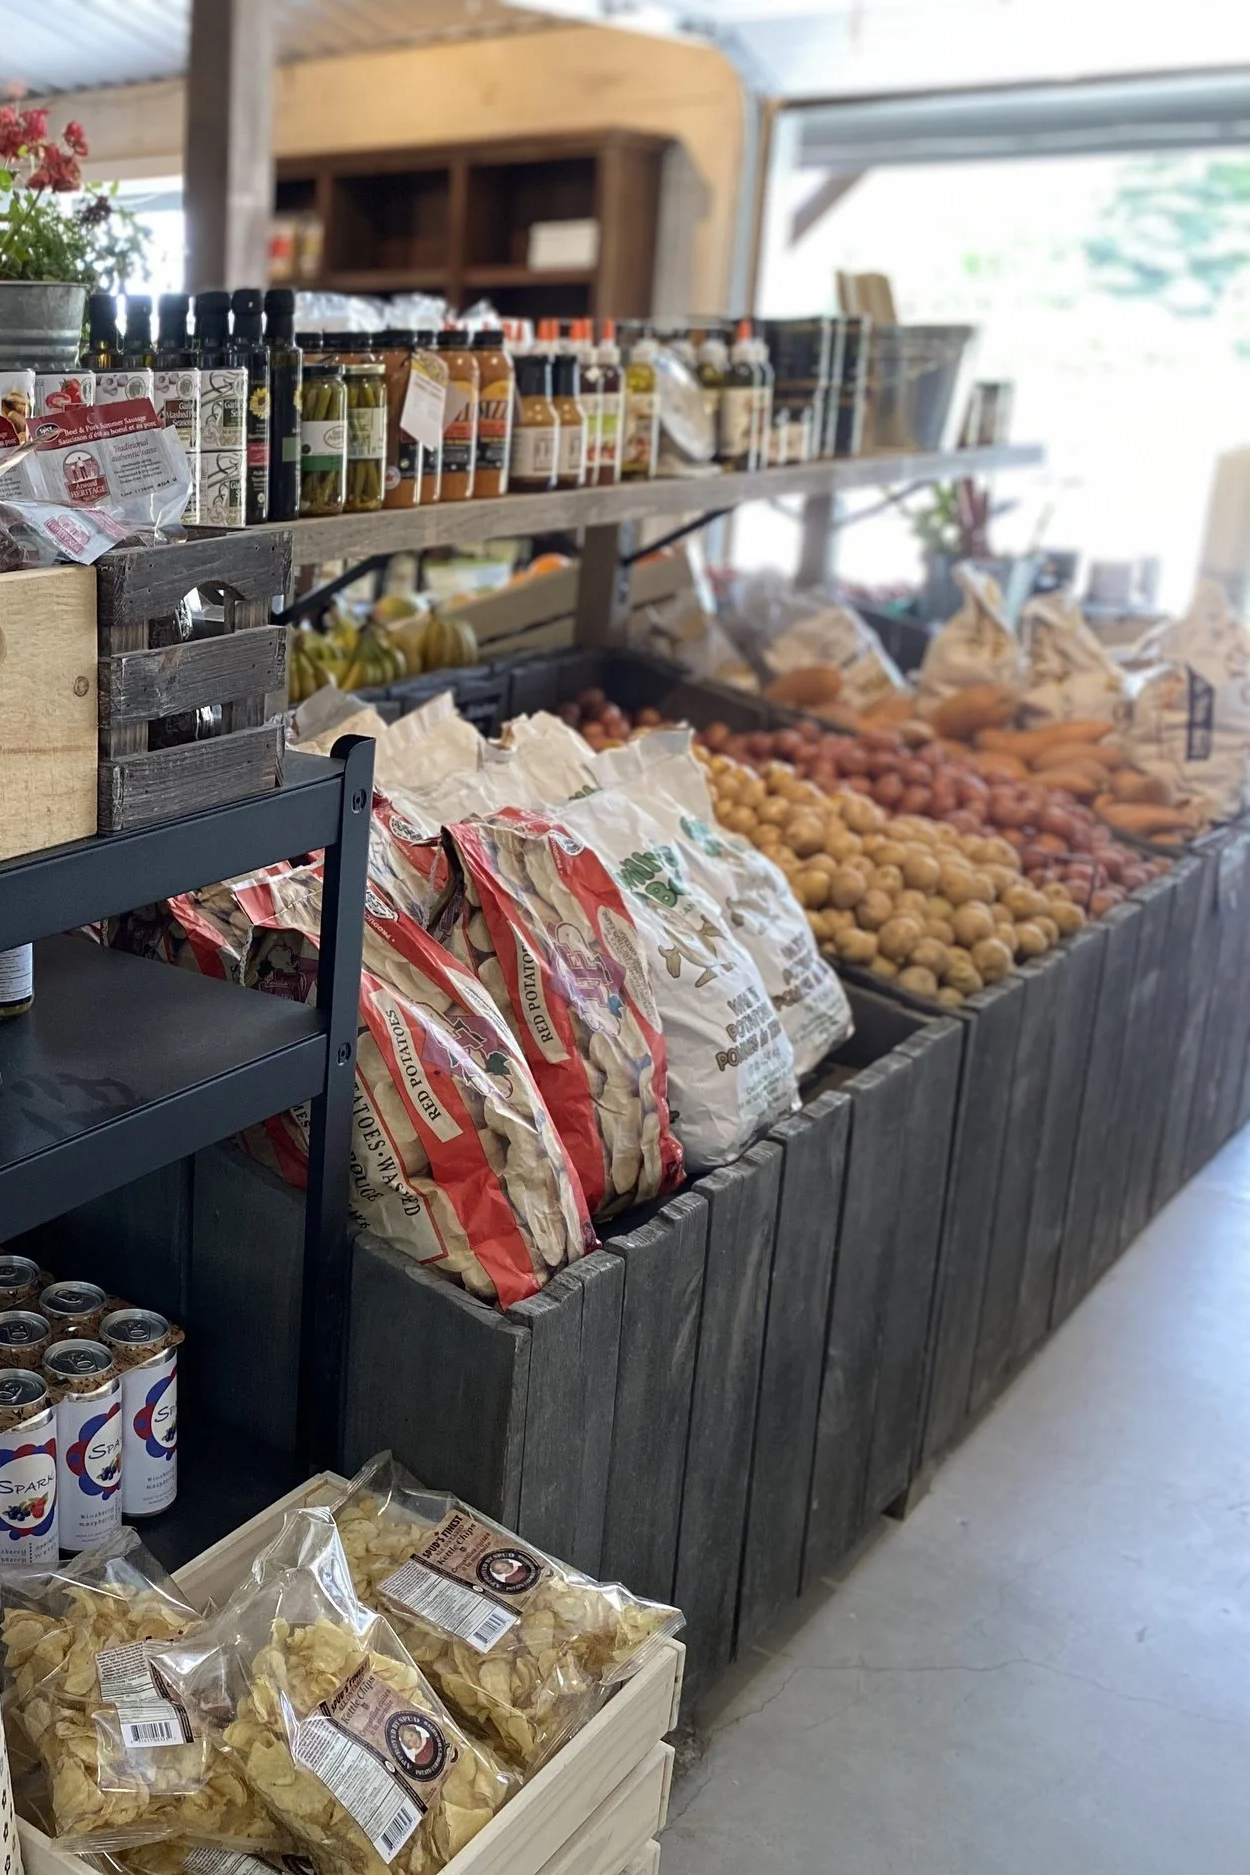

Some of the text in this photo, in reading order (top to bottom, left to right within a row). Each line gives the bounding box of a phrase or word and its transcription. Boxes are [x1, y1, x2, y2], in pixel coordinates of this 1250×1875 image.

[58, 434, 88, 445] Saucisson
[64, 428, 78, 436] Beef
[86, 424, 99, 432] Pork
[124, 415, 146, 424] Sausage
[531, 1015, 554, 1044] RED
[386, 1008, 442, 1123] RED POTATOES
[422, 1514, 464, 1560] SPUD'S FINEST
[437, 1522, 477, 1566] Kettle Chips
[340, 1674, 376, 1725] Kettle Chips
[399, 1715, 421, 1724] SPUD
